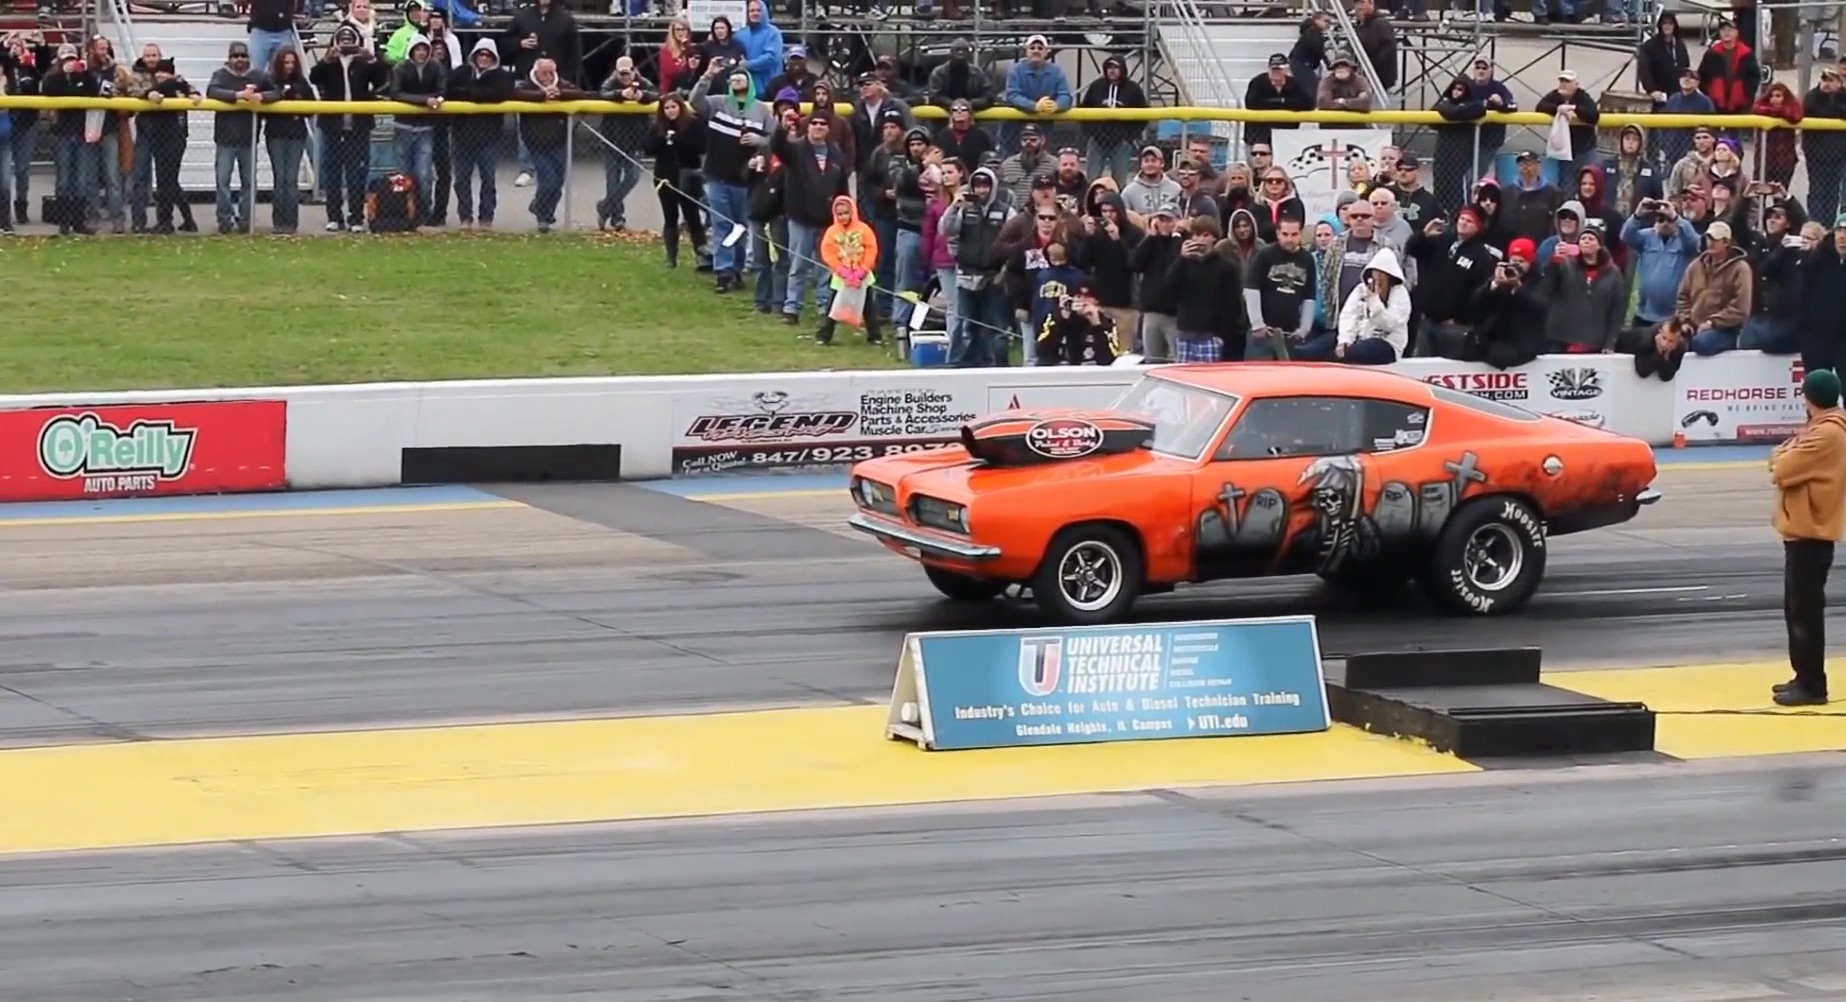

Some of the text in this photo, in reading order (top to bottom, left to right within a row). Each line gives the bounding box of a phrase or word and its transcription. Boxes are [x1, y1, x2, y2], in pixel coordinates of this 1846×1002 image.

[1424, 373, 1528, 390] ESTSIDE
[860, 393, 953, 406] Engine Builders
[1552, 388, 1600, 398] VINTAGE
[1686, 387, 1788, 401] REDHORSE
[860, 403, 947, 415] Machine Shop
[692, 413, 857, 434] LEGEND
[860, 414, 892, 425] Parts
[904, 412, 976, 424] Accessories
[860, 425, 902, 436] Muscle
[904, 424, 926, 434] Car
[1032, 427, 1096, 439] OLSON
[44, 417, 193, 475] O'Reilly
[707, 450, 738, 464] NOW
[84, 475, 155, 492] AUTO PARTS
[1256, 495, 1278, 510] RIP
[1067, 634, 1163, 655] UNIVERSAL
[1067, 653, 1162, 675] TECHNICAL
[1067, 672, 1159, 694] INSTITUTE
[954, 705, 1015, 720] Industry's
[1020, 702, 1062, 717] Choice
[1068, 701, 1084, 714] for
[1092, 700, 1119, 712] Auto
[1141, 696, 1178, 710] Diesel
[1184, 693, 1247, 709] Technician
[1252, 690, 1301, 706] Training
[1015, 724, 1062, 737] Glendale
[1132, 718, 1173, 731] Campus
[1197, 714, 1248, 730] UTI.edu
